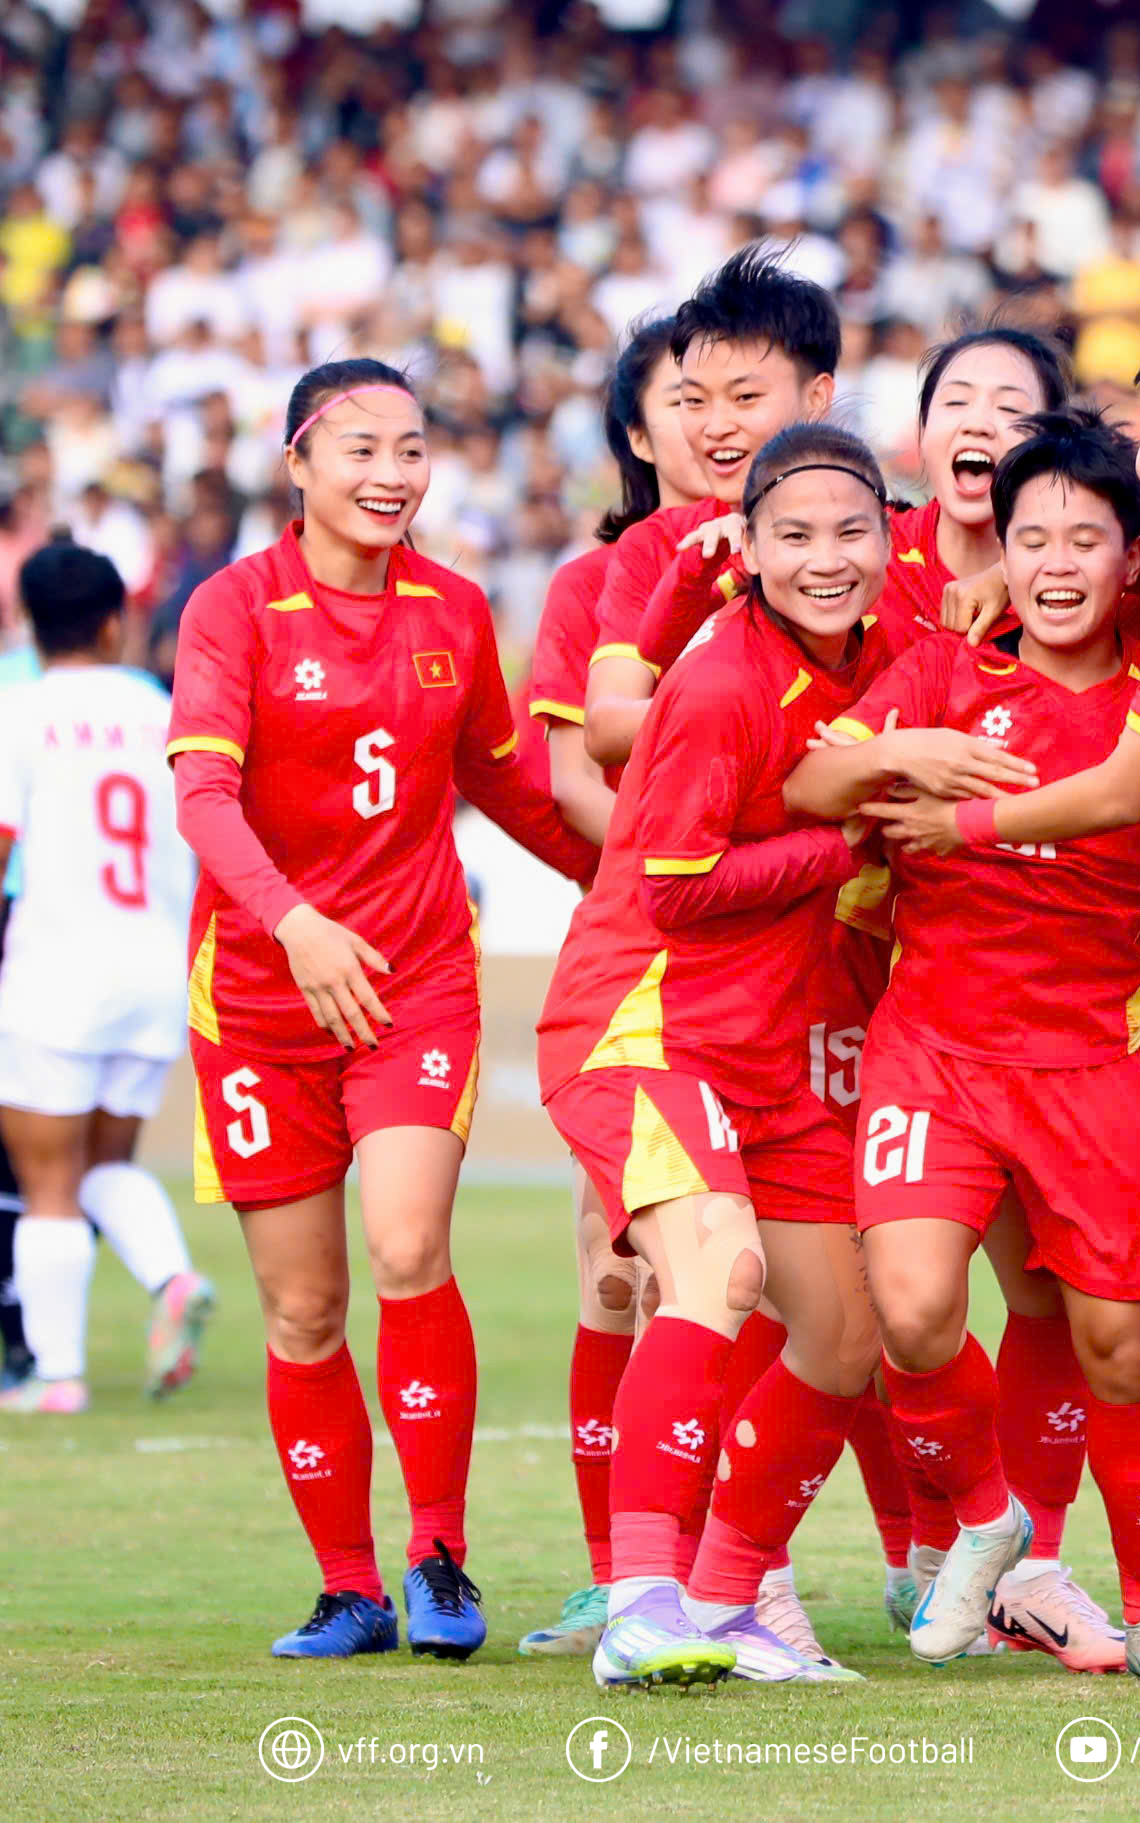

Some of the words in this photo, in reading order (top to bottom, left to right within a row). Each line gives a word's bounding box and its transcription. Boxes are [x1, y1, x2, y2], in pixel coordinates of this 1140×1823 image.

[353, 728, 396, 820] 5
[96, 772, 149, 910] 9
[808, 1022, 868, 1108] 15
[221, 1067, 272, 1159] 5
[863, 1104, 931, 1187] 21
